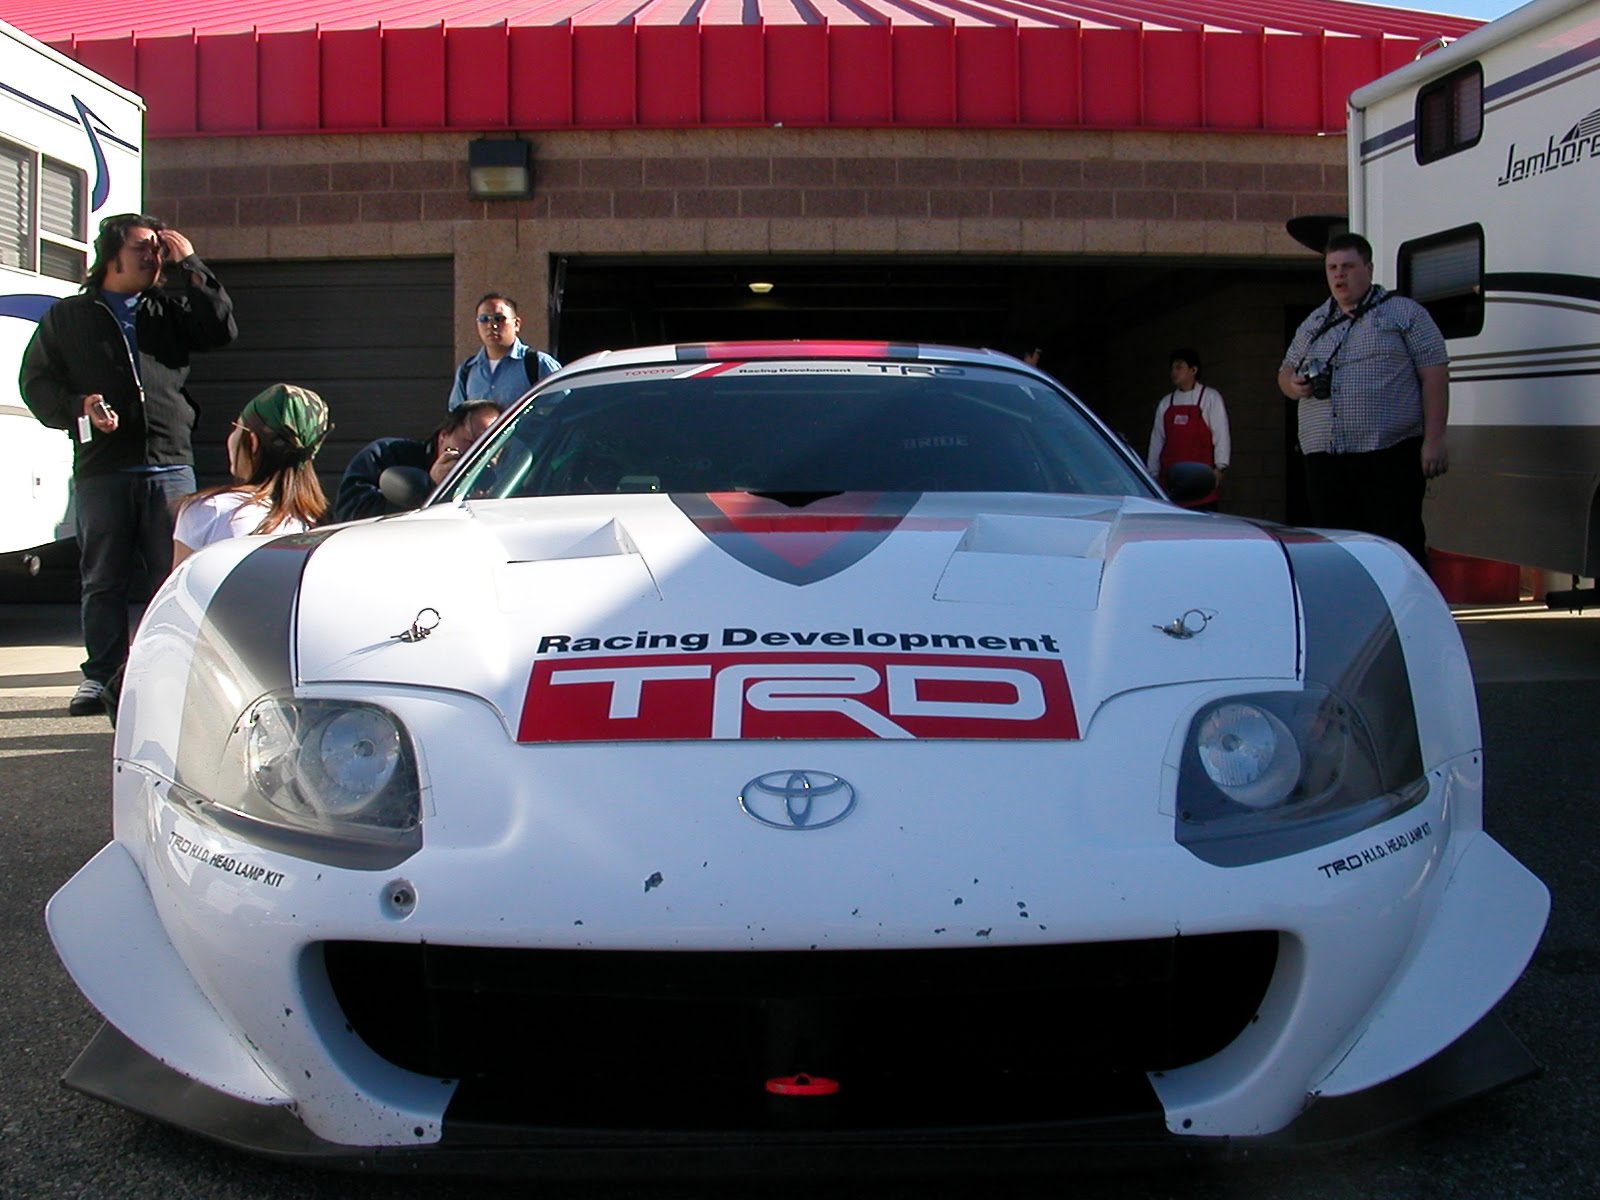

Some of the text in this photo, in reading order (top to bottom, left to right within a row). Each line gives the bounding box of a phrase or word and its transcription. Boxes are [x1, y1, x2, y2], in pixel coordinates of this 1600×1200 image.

[624, 368, 676, 376] TOYOTA
[867, 364, 966, 377] TRD
[903, 435, 969, 449] BRIDE
[536, 628, 1061, 653] Racing Development
[549, 663, 1047, 739] TRD
[169, 831, 191, 854] TRD
[209, 853, 236, 872] HEAD
[235, 862, 265, 881] LAMP
[263, 871, 285, 887] KIT
[1318, 854, 1363, 878] TRD
[1361, 845, 1388, 864] H.I.D.
[1384, 835, 1408, 854] HEAD
[1405, 826, 1423, 845] LAMP
